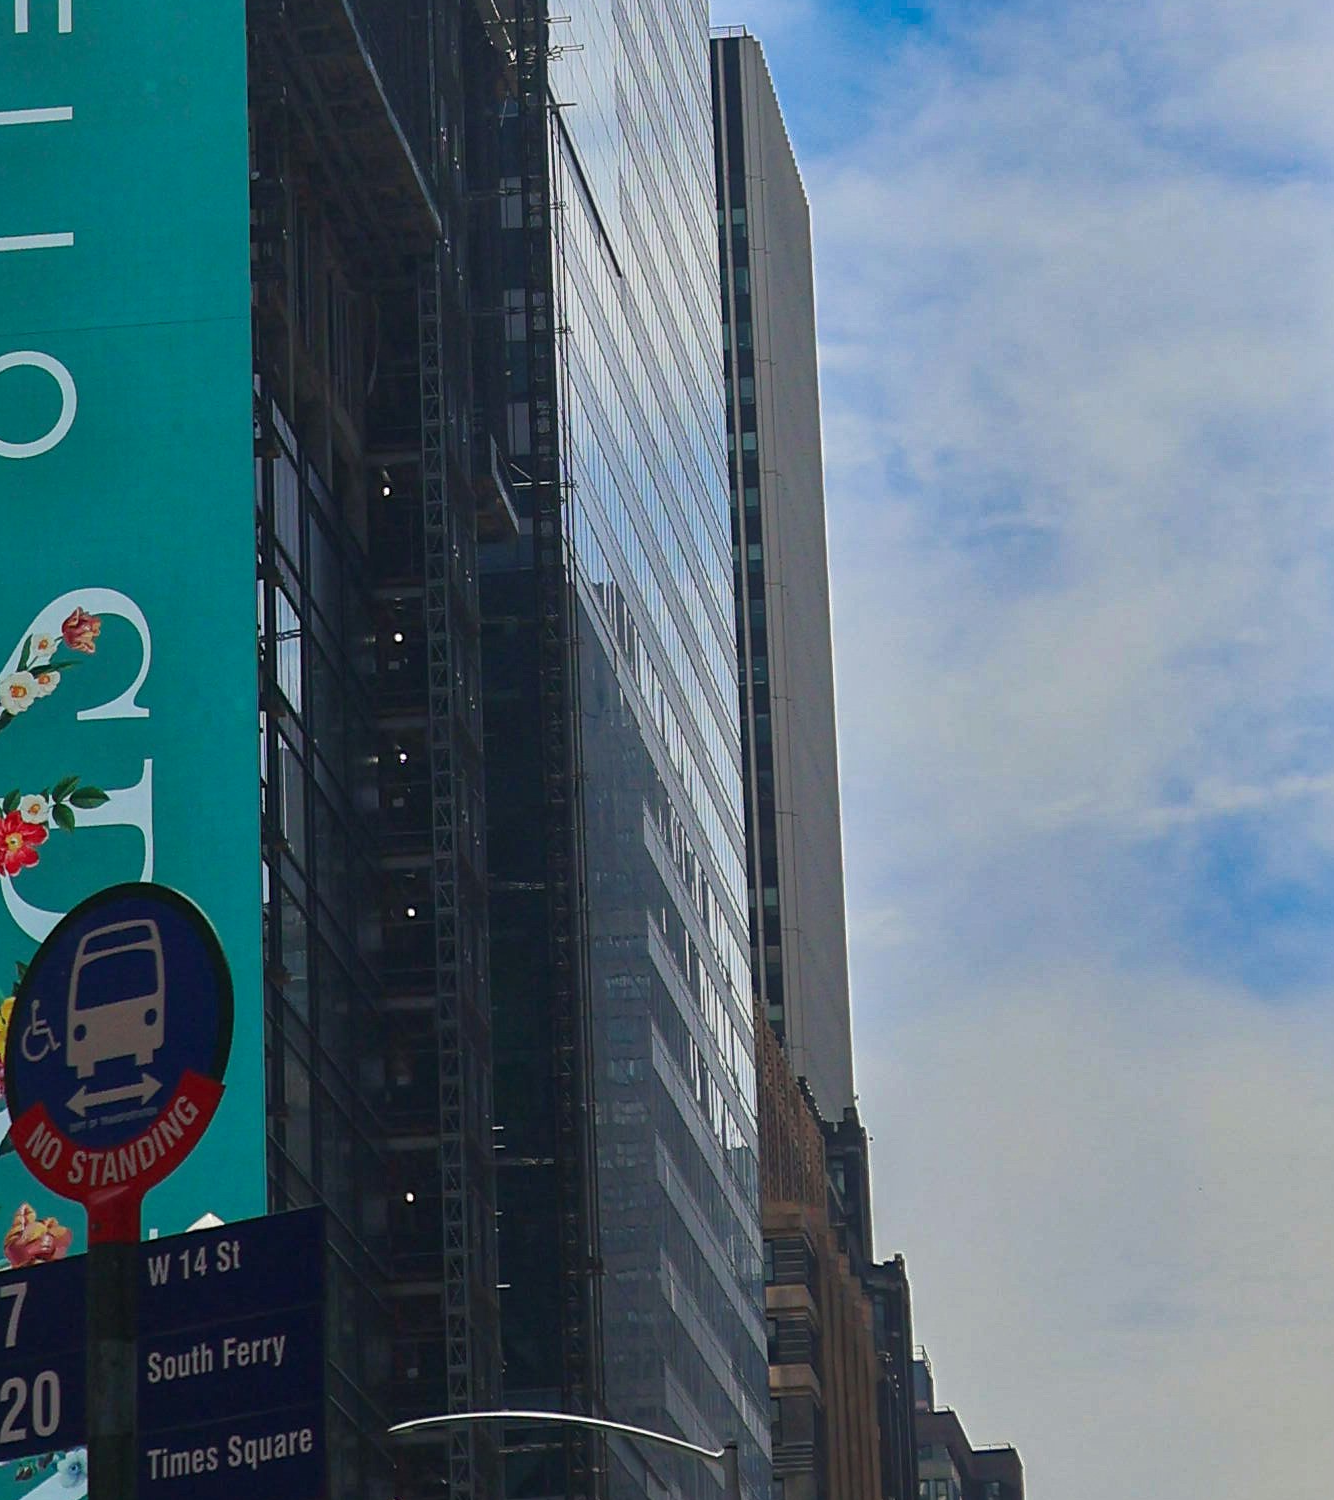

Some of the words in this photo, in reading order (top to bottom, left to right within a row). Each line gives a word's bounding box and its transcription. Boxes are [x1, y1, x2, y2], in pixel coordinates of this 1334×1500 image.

[24, 1119, 59, 1173] NO
[67, 1094, 199, 1187] STANDING
[147, 1253, 170, 1287] W
[179, 1248, 208, 1280] 14
[216, 1240, 242, 1272] St
[147, 1345, 214, 1384] South
[221, 1333, 287, 1376] Ferry
[147, 1440, 219, 1481] Times
[227, 1426, 314, 1472] Square
